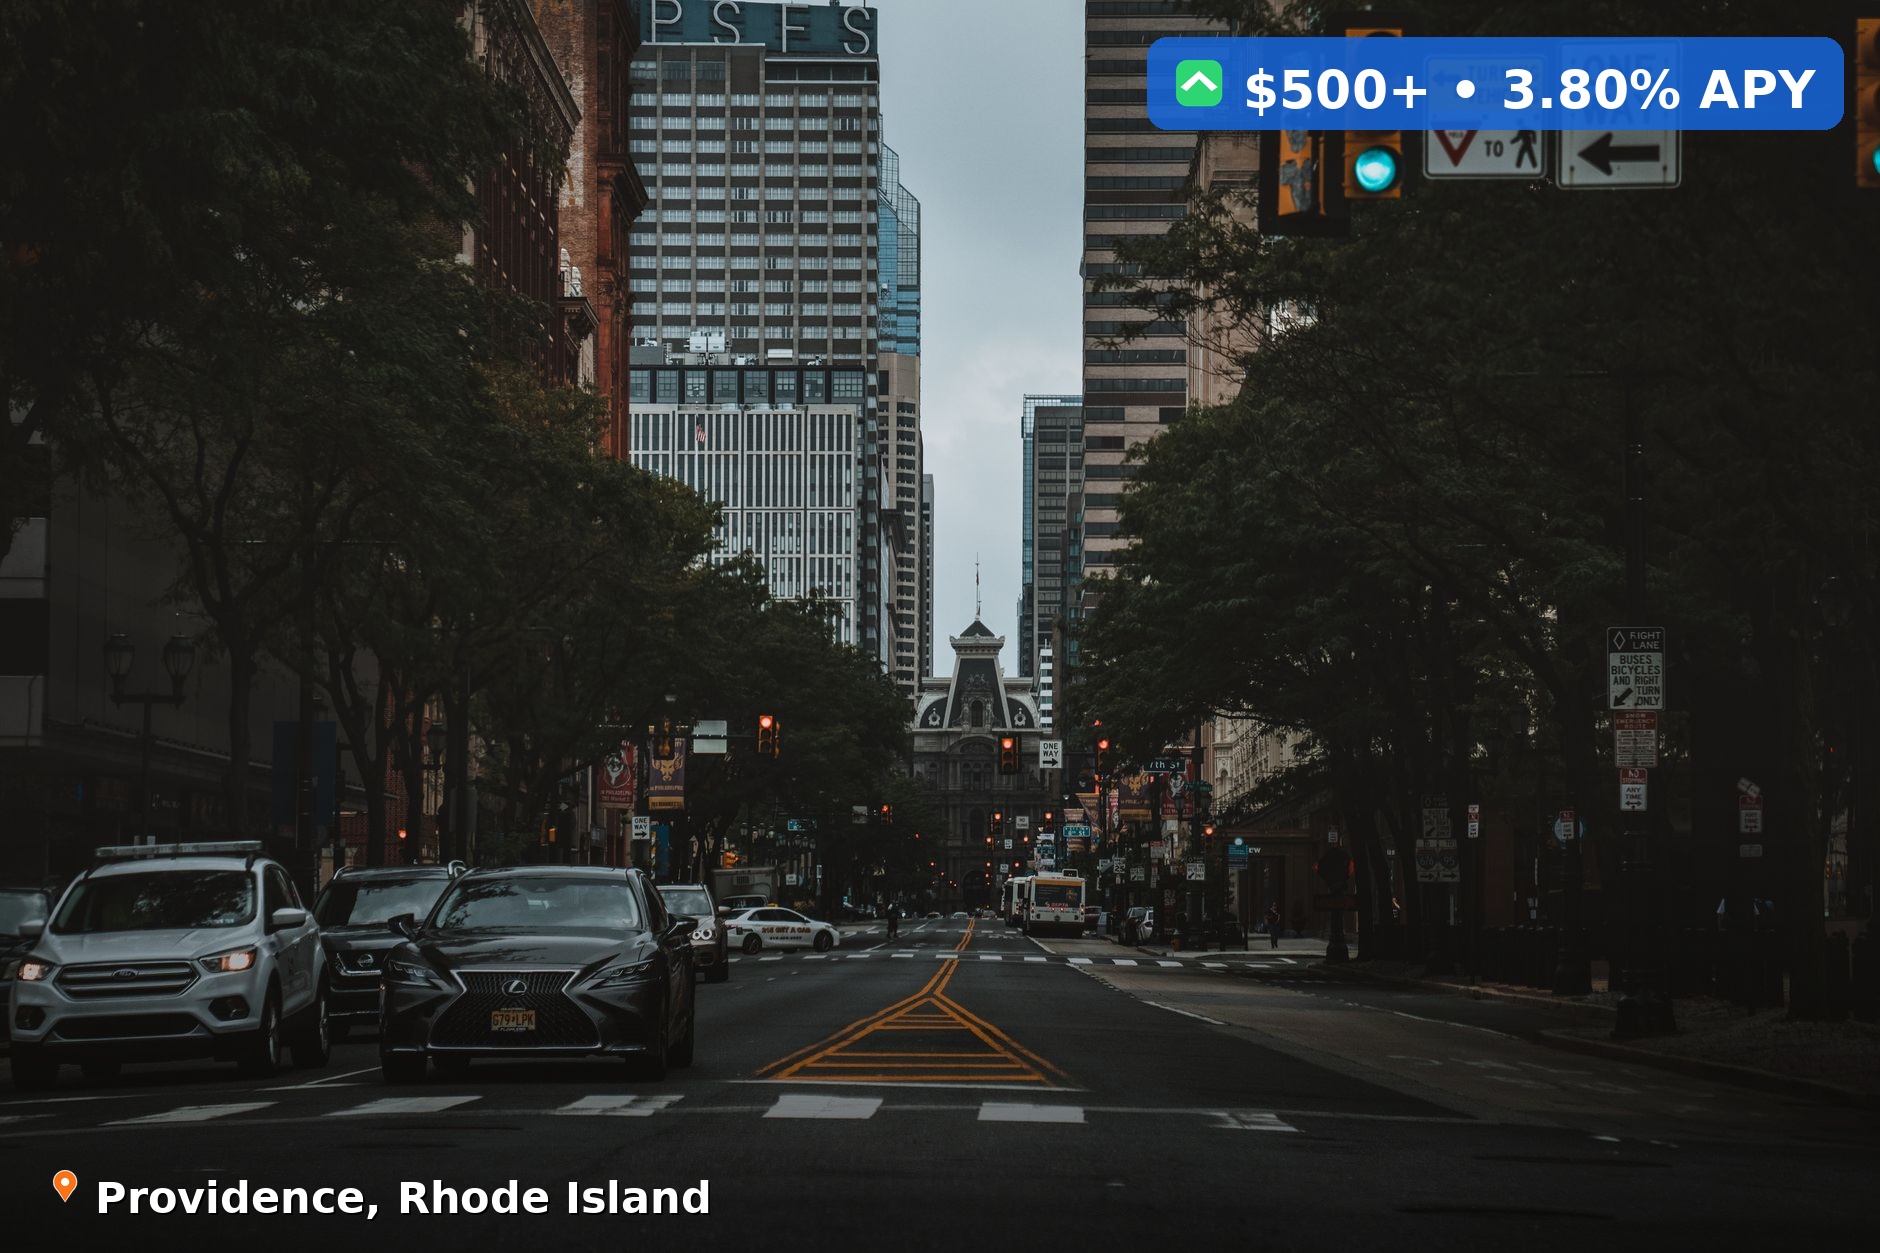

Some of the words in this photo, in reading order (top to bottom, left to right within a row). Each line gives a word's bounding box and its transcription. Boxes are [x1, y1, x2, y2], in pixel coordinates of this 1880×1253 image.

[651, 0, 870, 55] PSFS
[1484, 140, 1504, 158] TO
[1630, 631, 1662, 640] RIGHT
[1633, 641, 1661, 650] LANE
[1620, 654, 1652, 665] BUSES
[1611, 665, 1661, 675] BICYCLES
[1613, 676, 1631, 686] AND
[1635, 676, 1660, 686] RIGHT
[1637, 686, 1661, 695] TURN
[1637, 696, 1661, 706] ONLY
[1043, 742, 1059, 750] ONE
[1043, 750, 1059, 758] WAY
